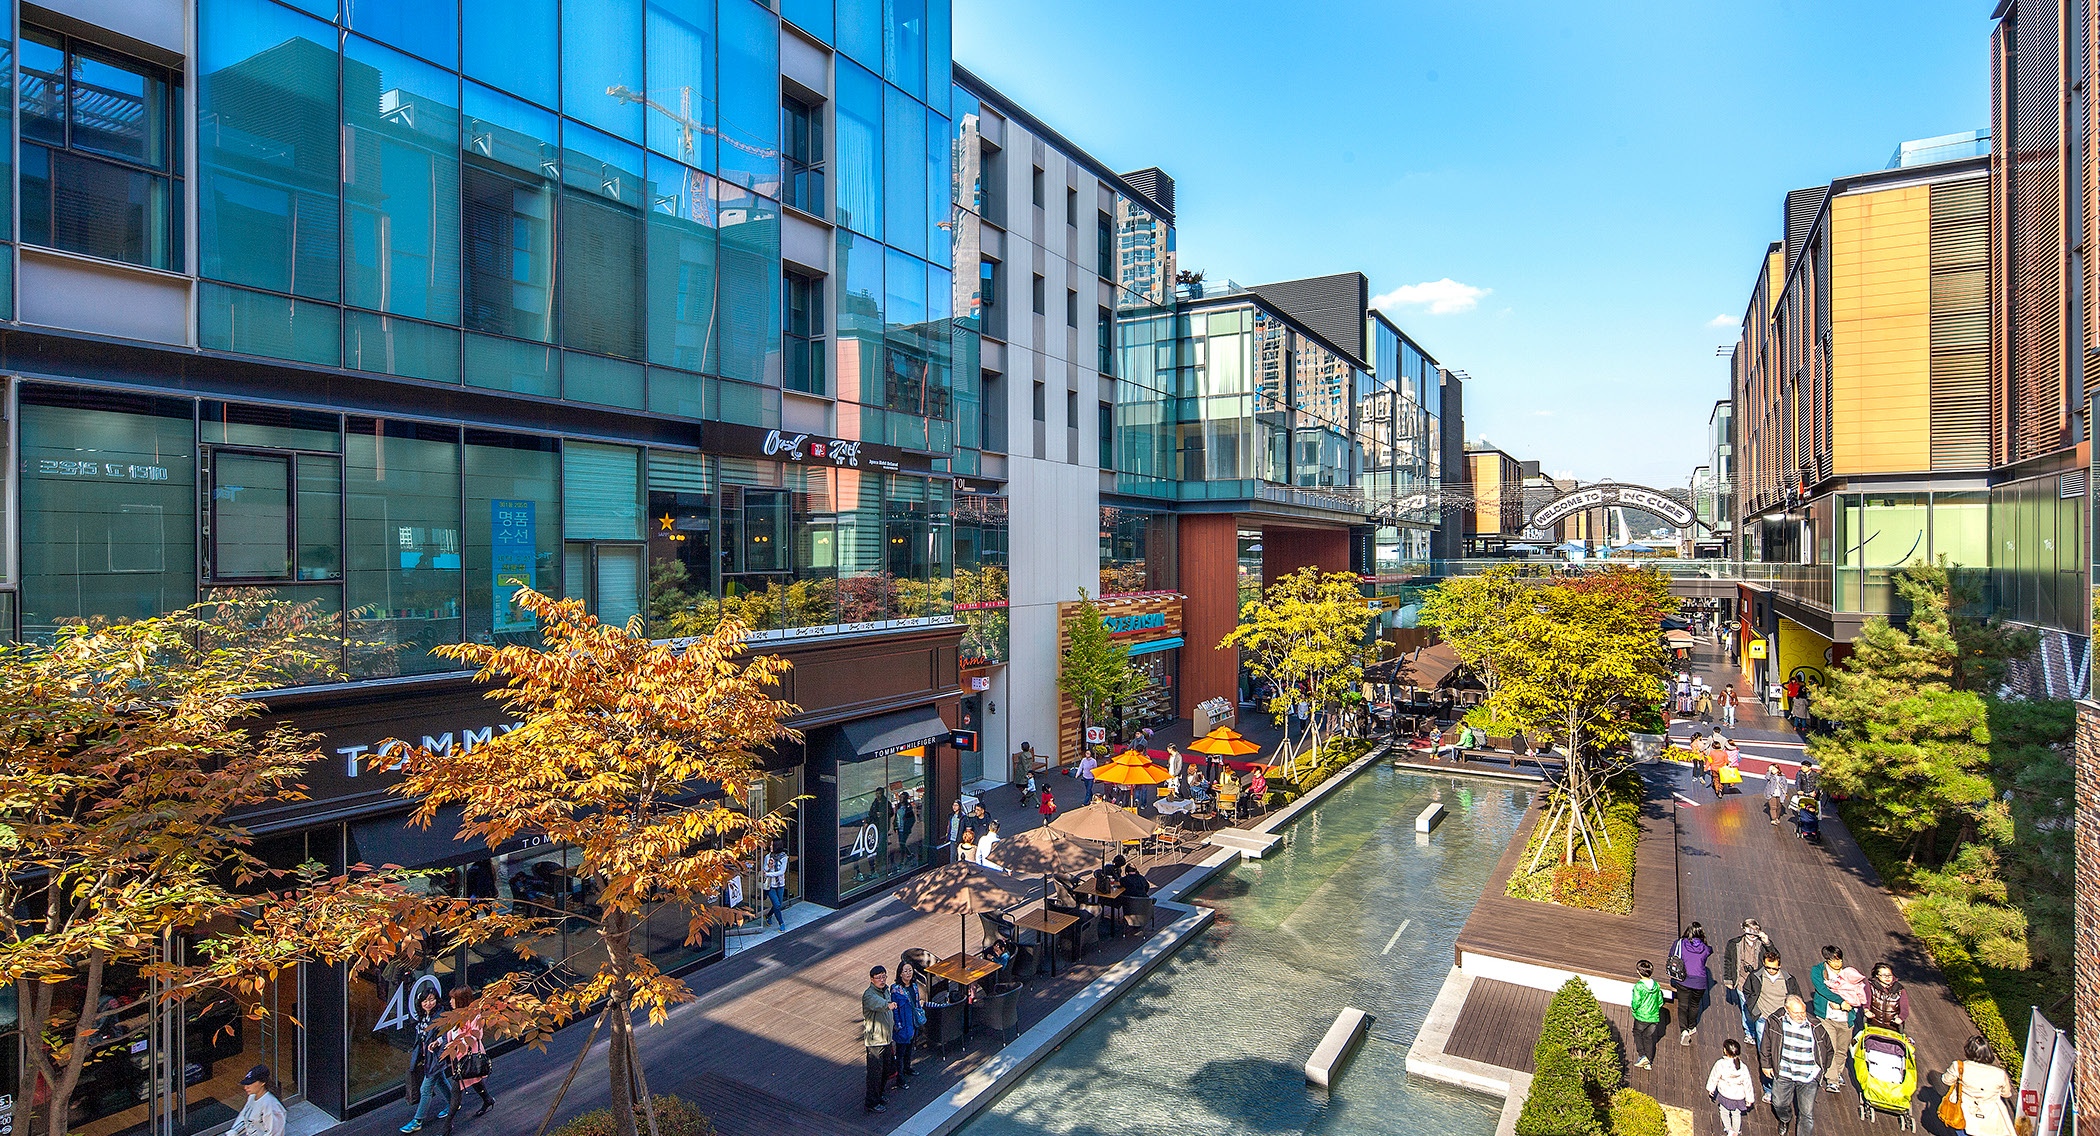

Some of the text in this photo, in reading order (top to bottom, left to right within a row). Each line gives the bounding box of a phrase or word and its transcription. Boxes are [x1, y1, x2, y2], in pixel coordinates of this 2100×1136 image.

[1536, 492, 1686, 524] WELCOME TO NC CUBE
[499, 511, 529, 527] 명품
[498, 529, 529, 544] 수선
[874, 736, 936, 758] TOMMY HILFIGER
